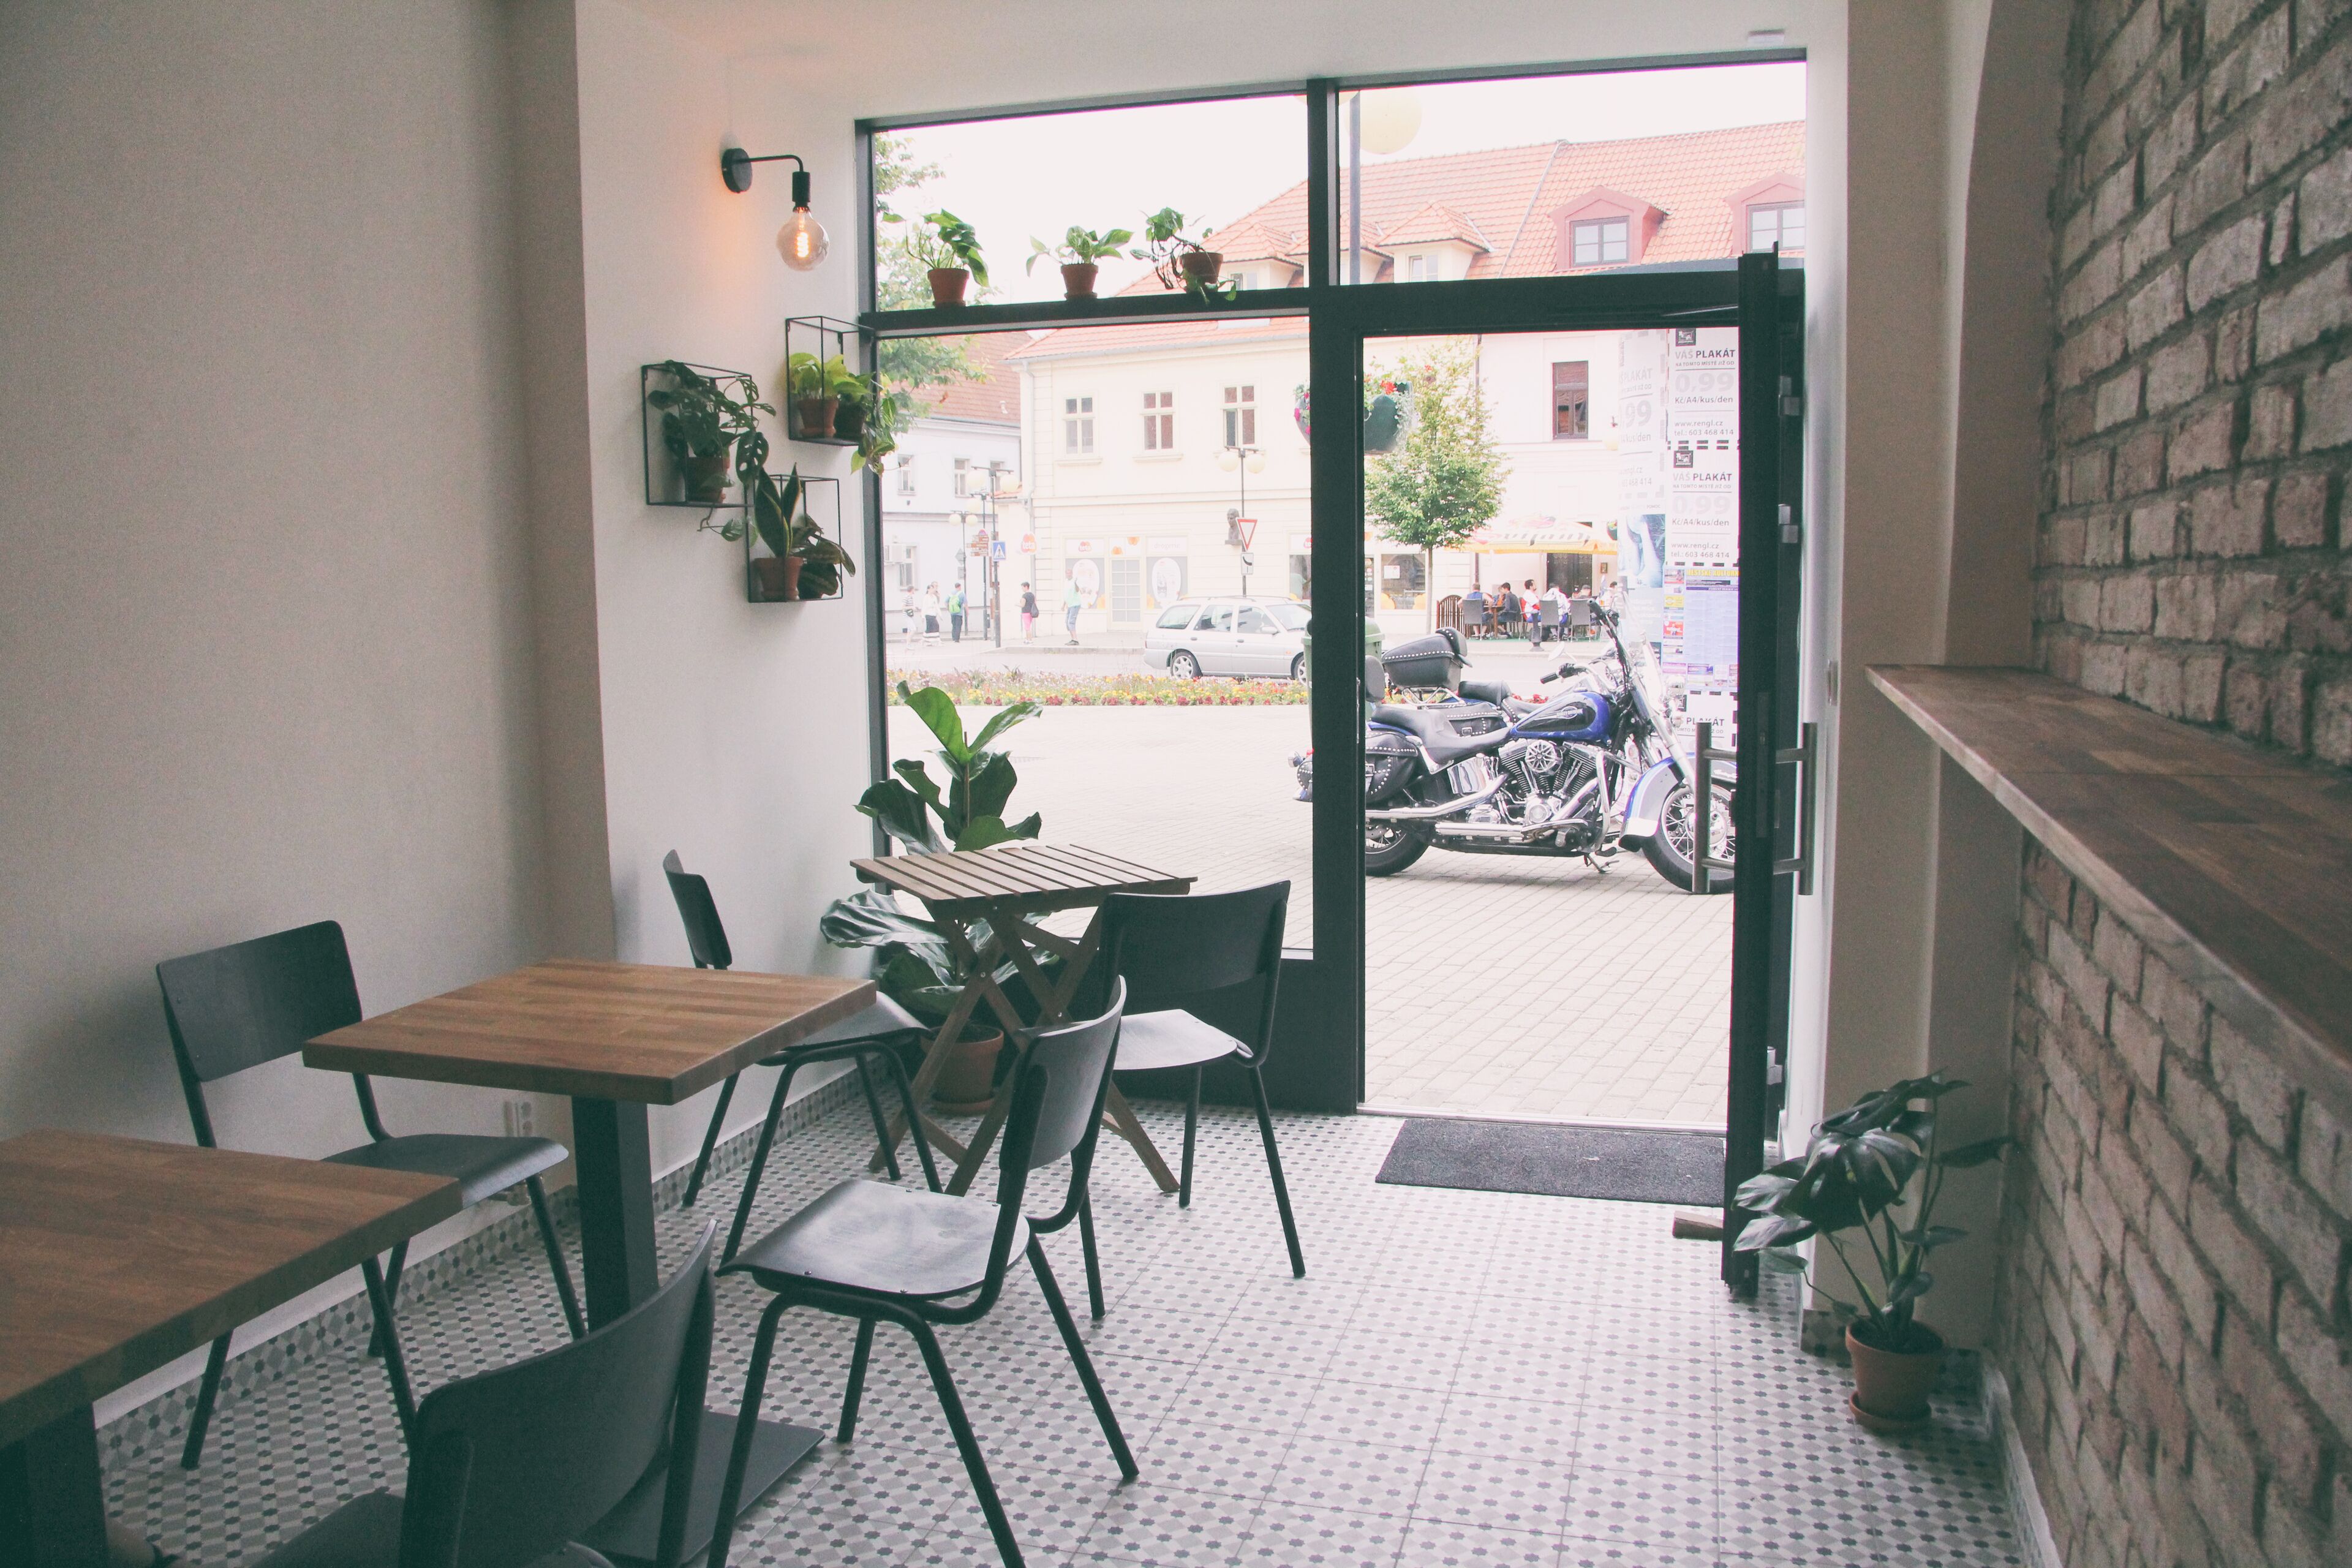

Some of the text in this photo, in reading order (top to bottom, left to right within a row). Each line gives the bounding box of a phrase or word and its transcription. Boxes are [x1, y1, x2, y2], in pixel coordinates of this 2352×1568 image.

[1675, 348, 1736, 359] VÁŠ PLAKÁT
[1675, 372, 1735, 393] 0,99
[1675, 396, 1733, 404] Kč/A4/kus/den
[1675, 419, 1723, 428] www.rengl.cz
[1673, 471, 1733, 481] VÁŠ PLAKÁT
[1673, 495, 1731, 515] 0,99
[1713, 568, 1740, 577] KULTURN
